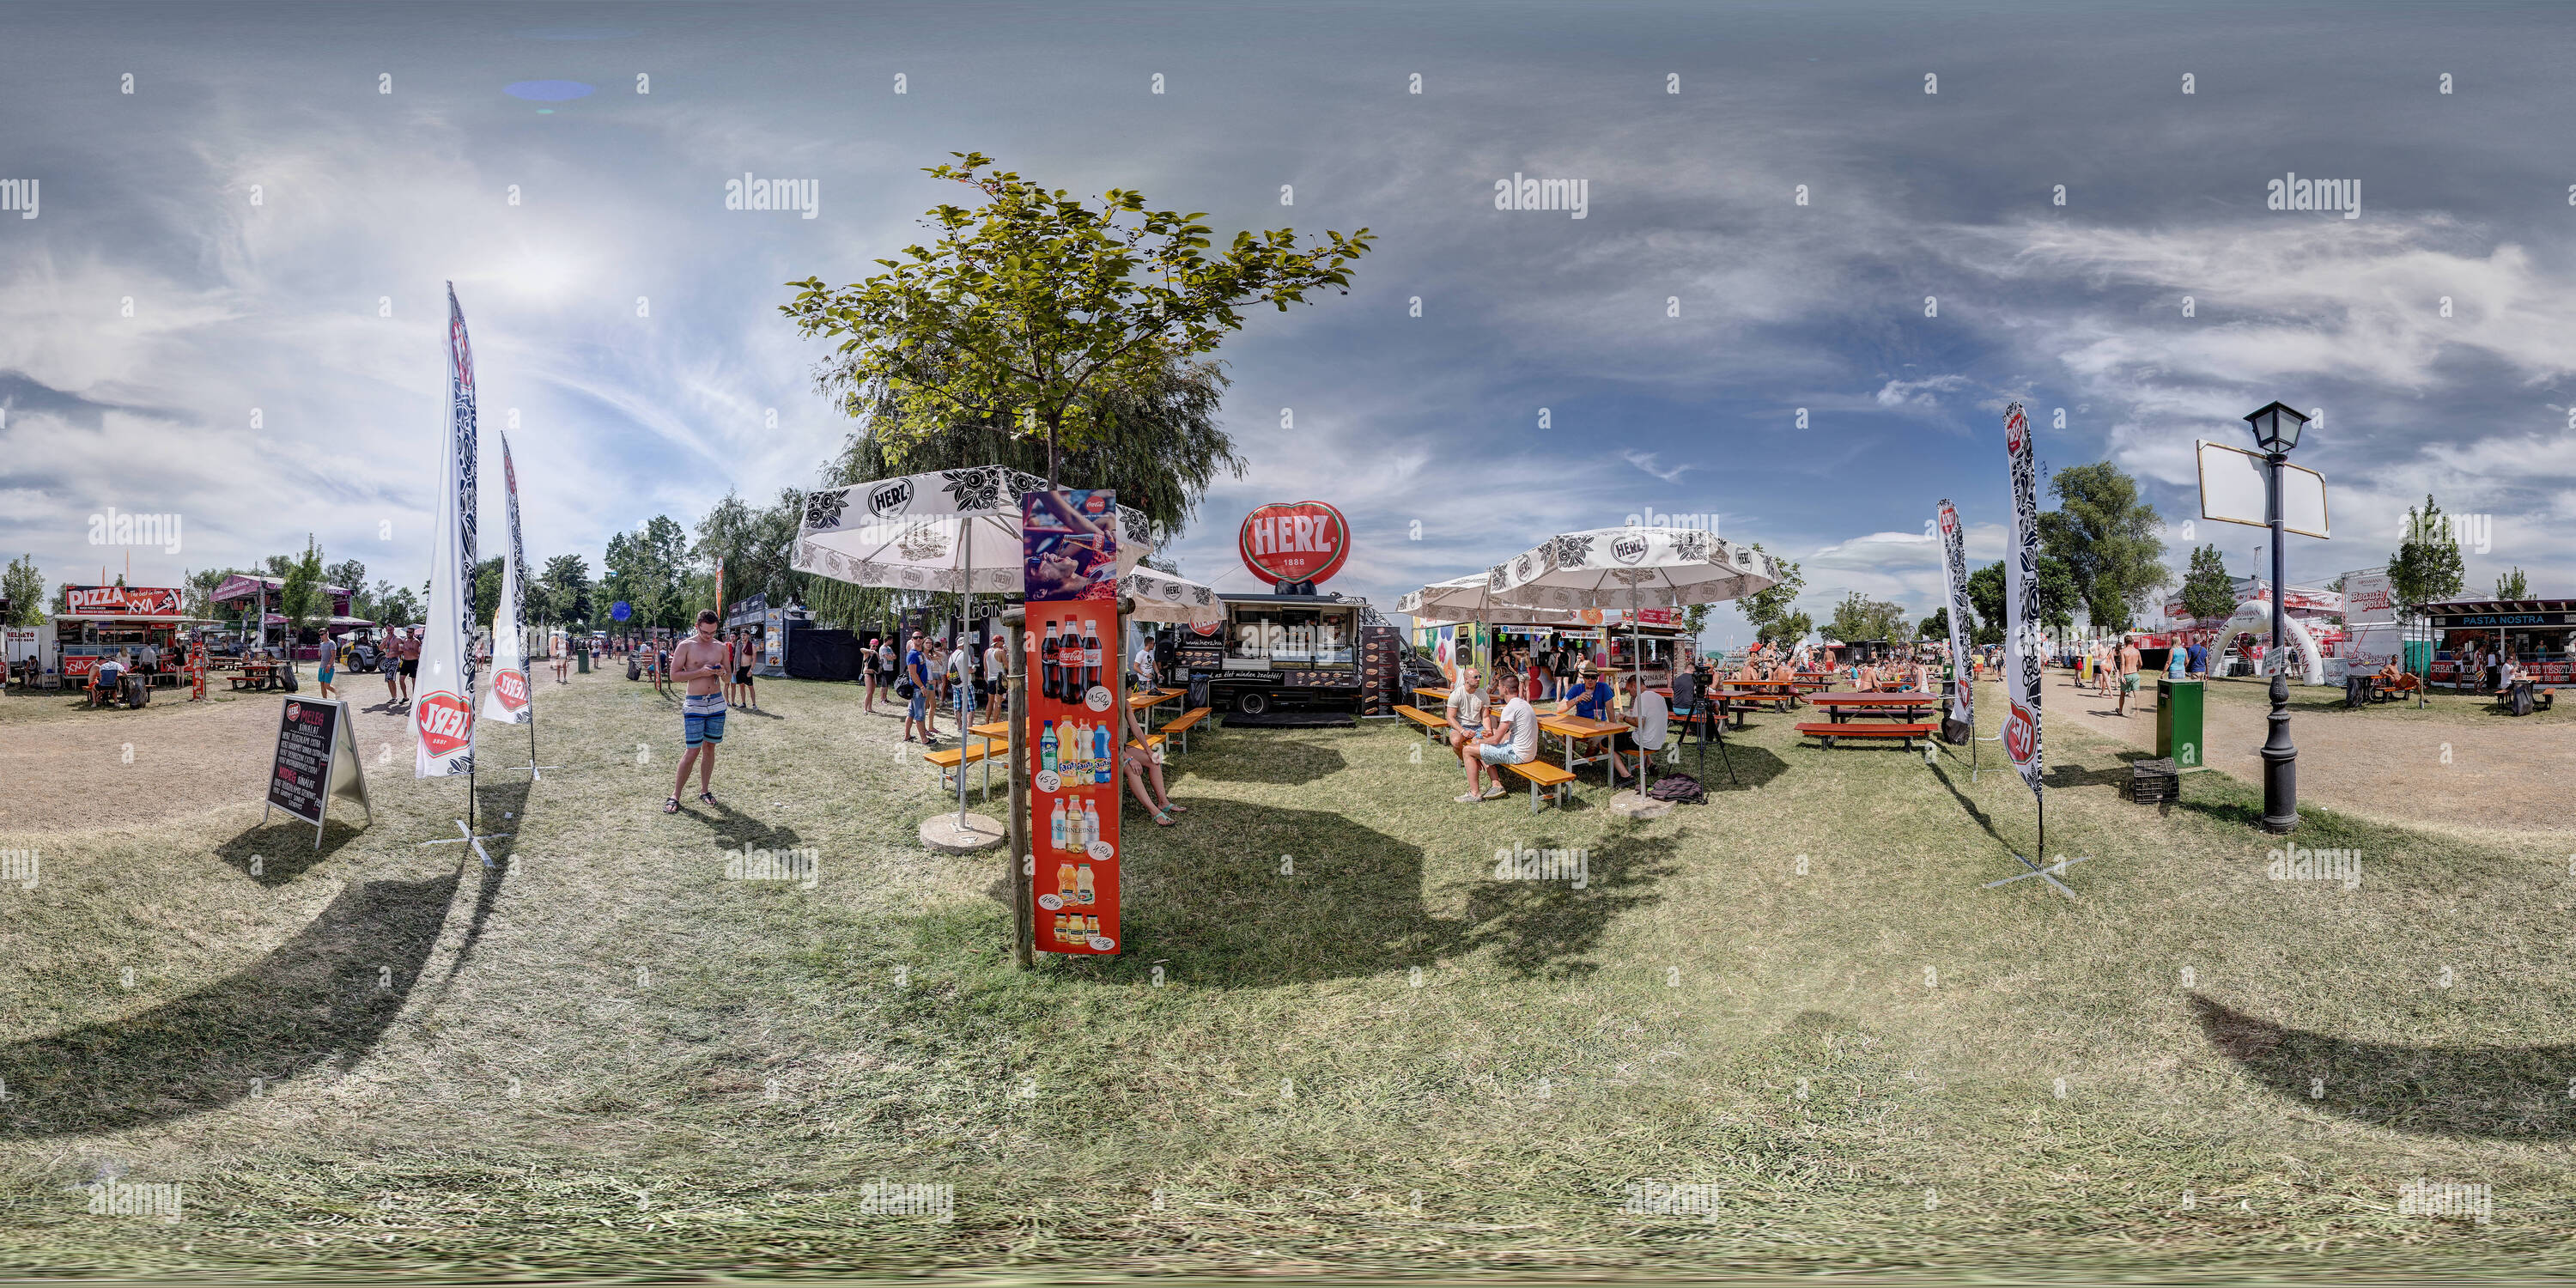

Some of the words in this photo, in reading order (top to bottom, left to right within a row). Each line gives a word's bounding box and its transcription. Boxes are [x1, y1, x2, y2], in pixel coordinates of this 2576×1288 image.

[874, 484, 908, 512] HERZ
[1254, 514, 1331, 556] HERZ
[1615, 536, 1643, 558] HERZ
[1737, 553, 1750, 565] HERZ
[1518, 560, 1530, 577] HERZ
[1165, 586, 1180, 595] HERZ
[2352, 591, 2387, 602] Beauty
[69, 587, 125, 614] PIZZA
[2363, 599, 2391, 611] point
[2464, 617, 2496, 625] PASTA
[2500, 616, 2544, 624] NOSTRA
[1060, 650, 1082, 661] Coca-Cola
[2431, 665, 2454, 673] CREAT
[289, 706, 299, 716] HERZ
[301, 709, 324, 726] MELEG
[1038, 774, 1058, 786] 450
